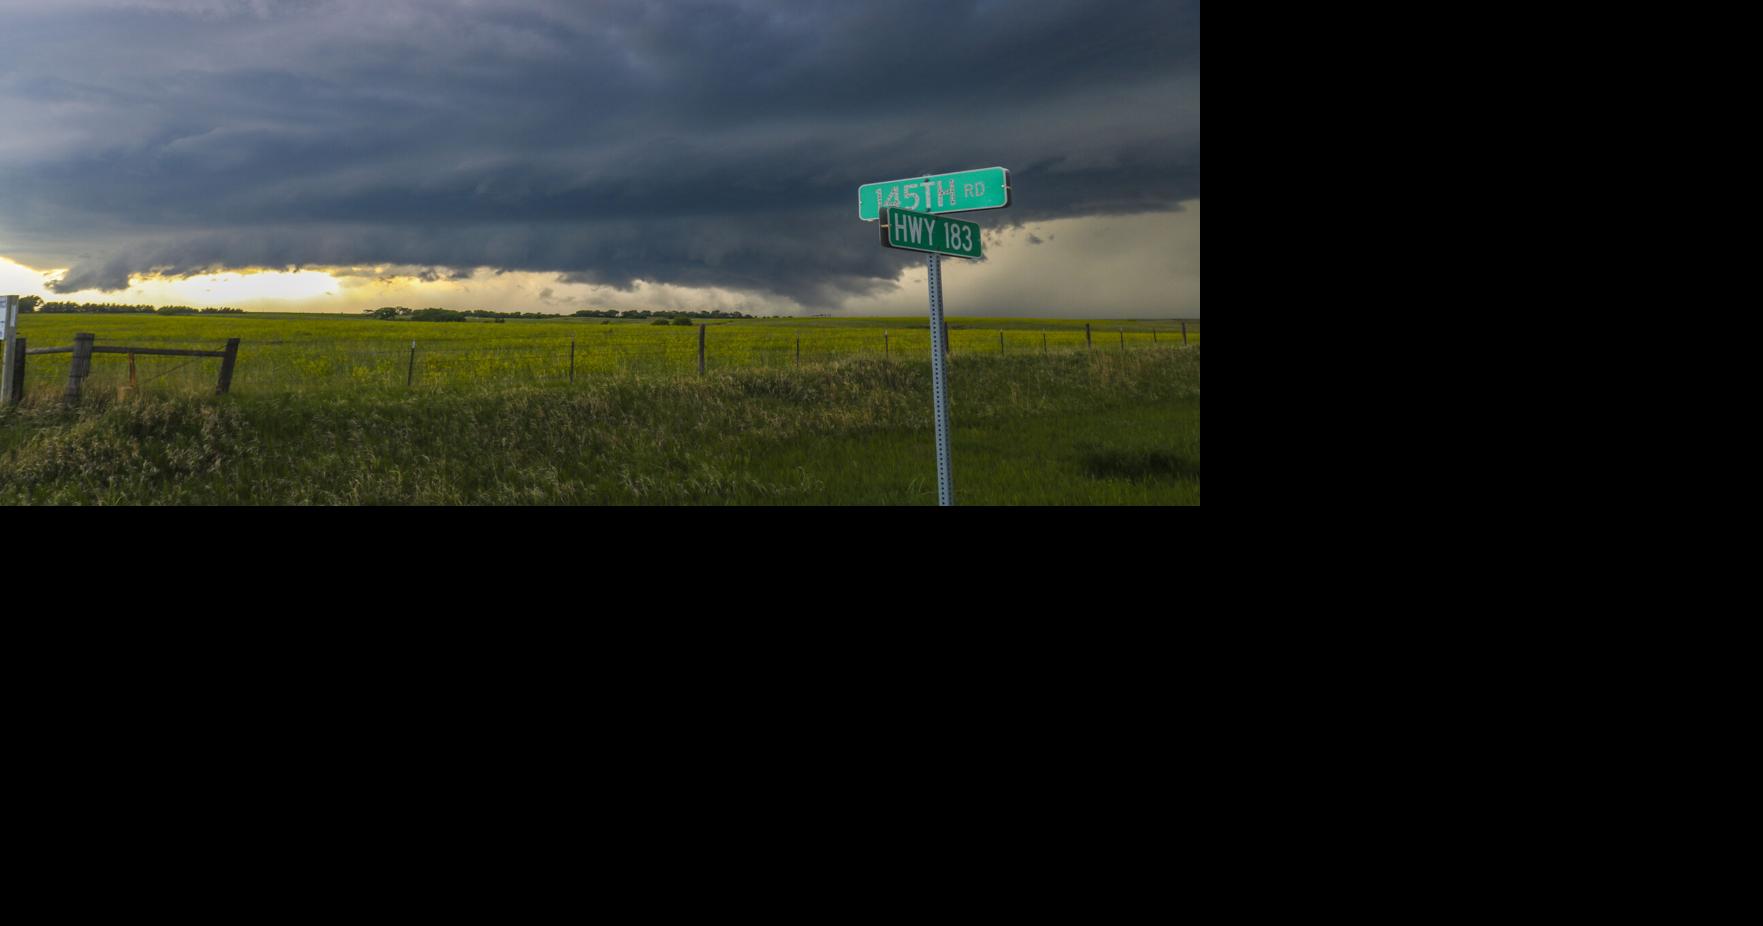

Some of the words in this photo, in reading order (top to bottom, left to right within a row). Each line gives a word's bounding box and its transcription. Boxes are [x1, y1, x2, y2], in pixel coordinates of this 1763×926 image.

[875, 179, 956, 210] 145TH
[964, 182, 985, 198] RD
[894, 213, 935, 246] HWY
[944, 223, 973, 252] 183
